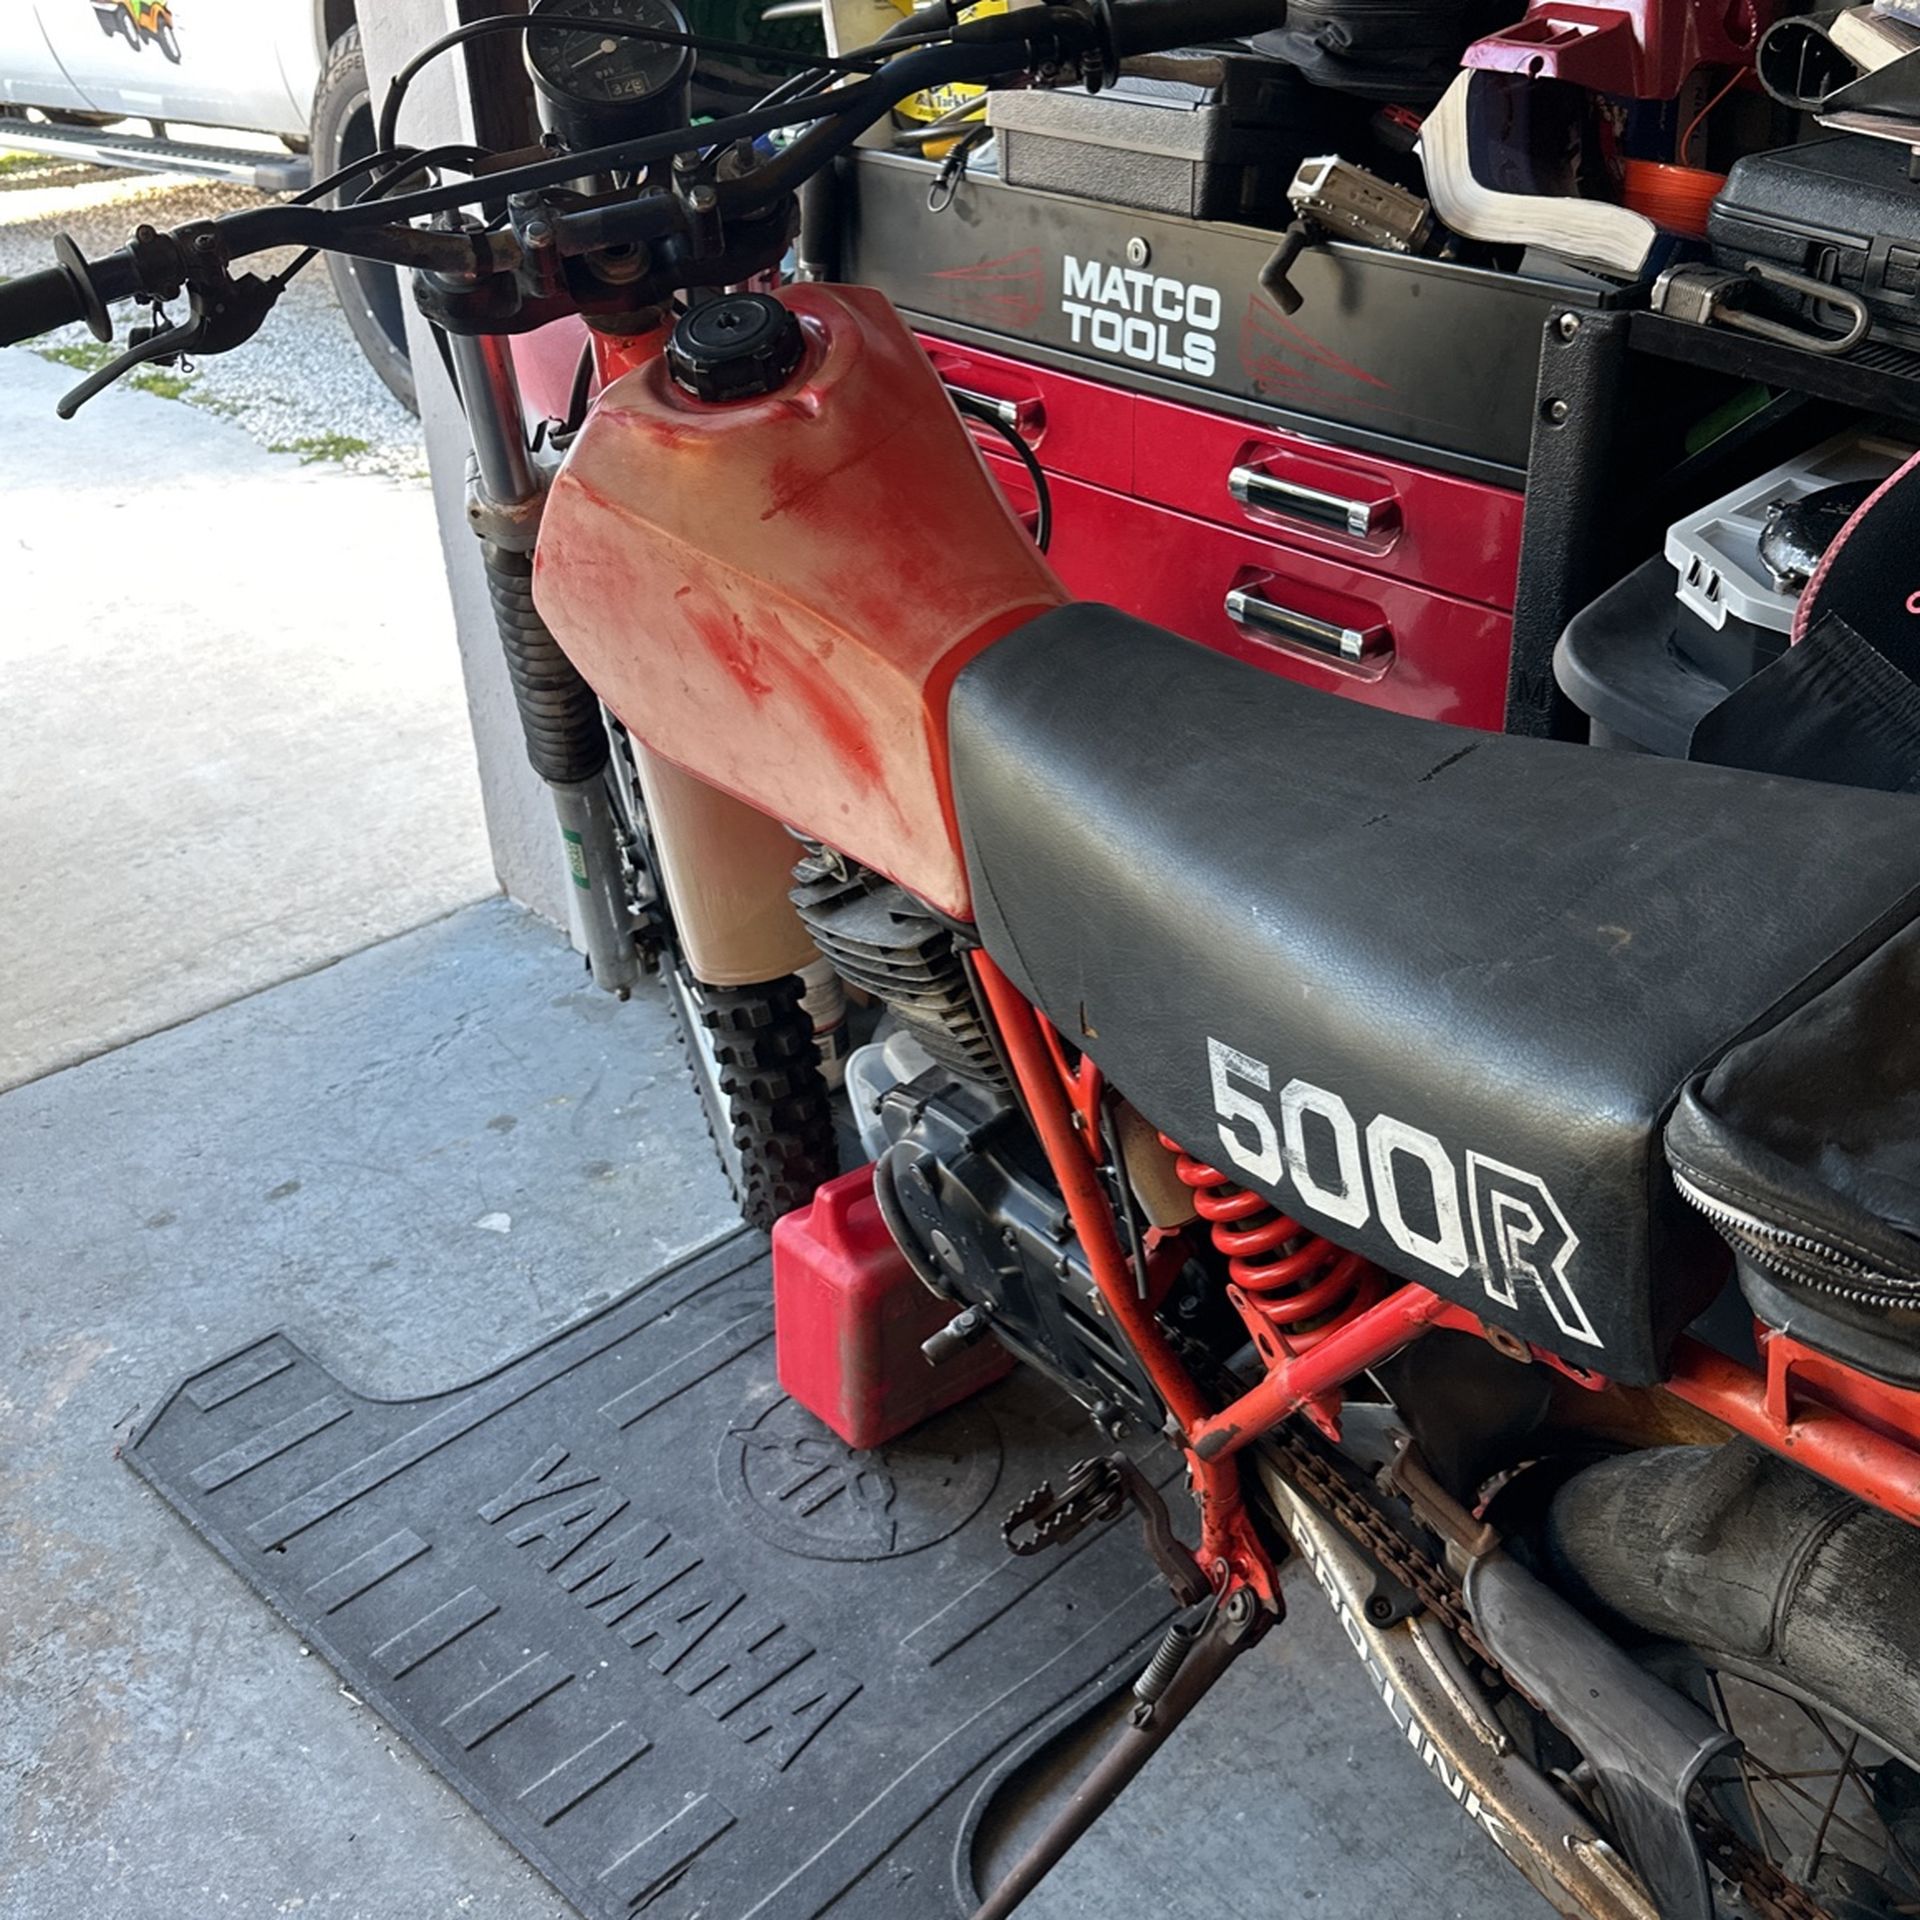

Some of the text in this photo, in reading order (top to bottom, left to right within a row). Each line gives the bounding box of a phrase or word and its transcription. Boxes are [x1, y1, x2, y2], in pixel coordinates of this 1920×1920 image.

[1062, 300, 1216, 377] TOOLS
[1063, 255, 1221, 331] MATCO
[1207, 1036, 1604, 1348] 500R
[478, 1442, 863, 1773] YAMAHA
[1291, 1510, 1512, 1857] PRO-LINK
